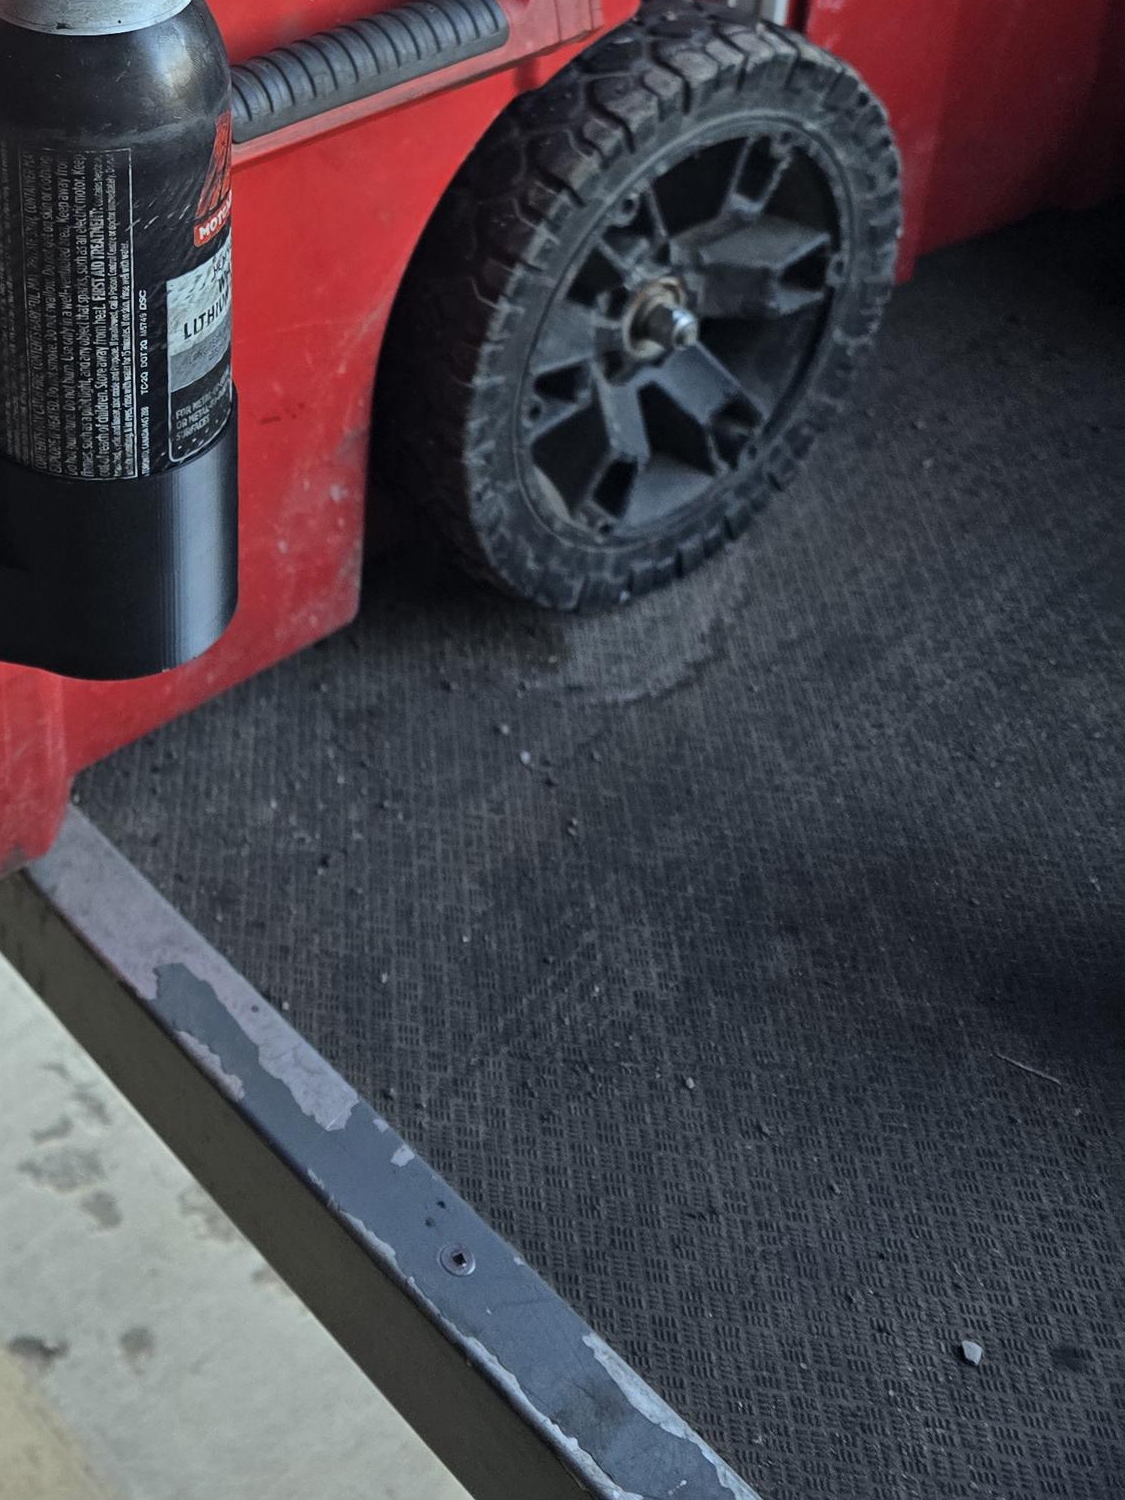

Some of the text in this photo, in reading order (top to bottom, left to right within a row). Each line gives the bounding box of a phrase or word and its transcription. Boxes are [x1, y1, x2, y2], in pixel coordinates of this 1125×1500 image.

[70, 153, 87, 175] Keep
[58, 177, 71, 201] away
[71, 176, 86, 203] motor.
[56, 201, 72, 223] Keep
[72, 203, 87, 233] electric
[106, 212, 118, 230] doctor
[75, 233, 88, 245] an
[88, 207, 105, 260] TREATMENT:
[75, 246, 88, 256] as
[73, 256, 88, 274] such
[90, 261, 105, 277] AID
[106, 255, 117, 276] Control
[75, 274, 91, 303] sparks,
[90, 277, 106, 302] FIRST
[107, 276, 118, 295] Poison
[138, 289, 147, 311] DSC
[75, 304, 90, 321] that
[91, 303, 107, 325] heat.
[59, 326, 75, 346] only
[75, 322, 92, 346] object
[92, 325, 107, 345] from
[78, 346, 93, 361] any
[139, 339, 148, 351] 2Q
[95, 346, 109, 368] away
[139, 351, 148, 368] DOT
[77, 361, 92, 377] and
[93, 368, 108, 389] Store
[77, 377, 94, 398] light,
[139, 371, 149, 395] TC-2Q
[94, 389, 109, 423] children.
[175, 404, 192, 420] FOR
[81, 422, 92, 431] as
[94, 423, 109, 432] of
[175, 417, 188, 430] OR
[175, 414, 211, 442] SURFACES
[78, 431, 93, 449] such
[94, 433, 110, 454] reach
